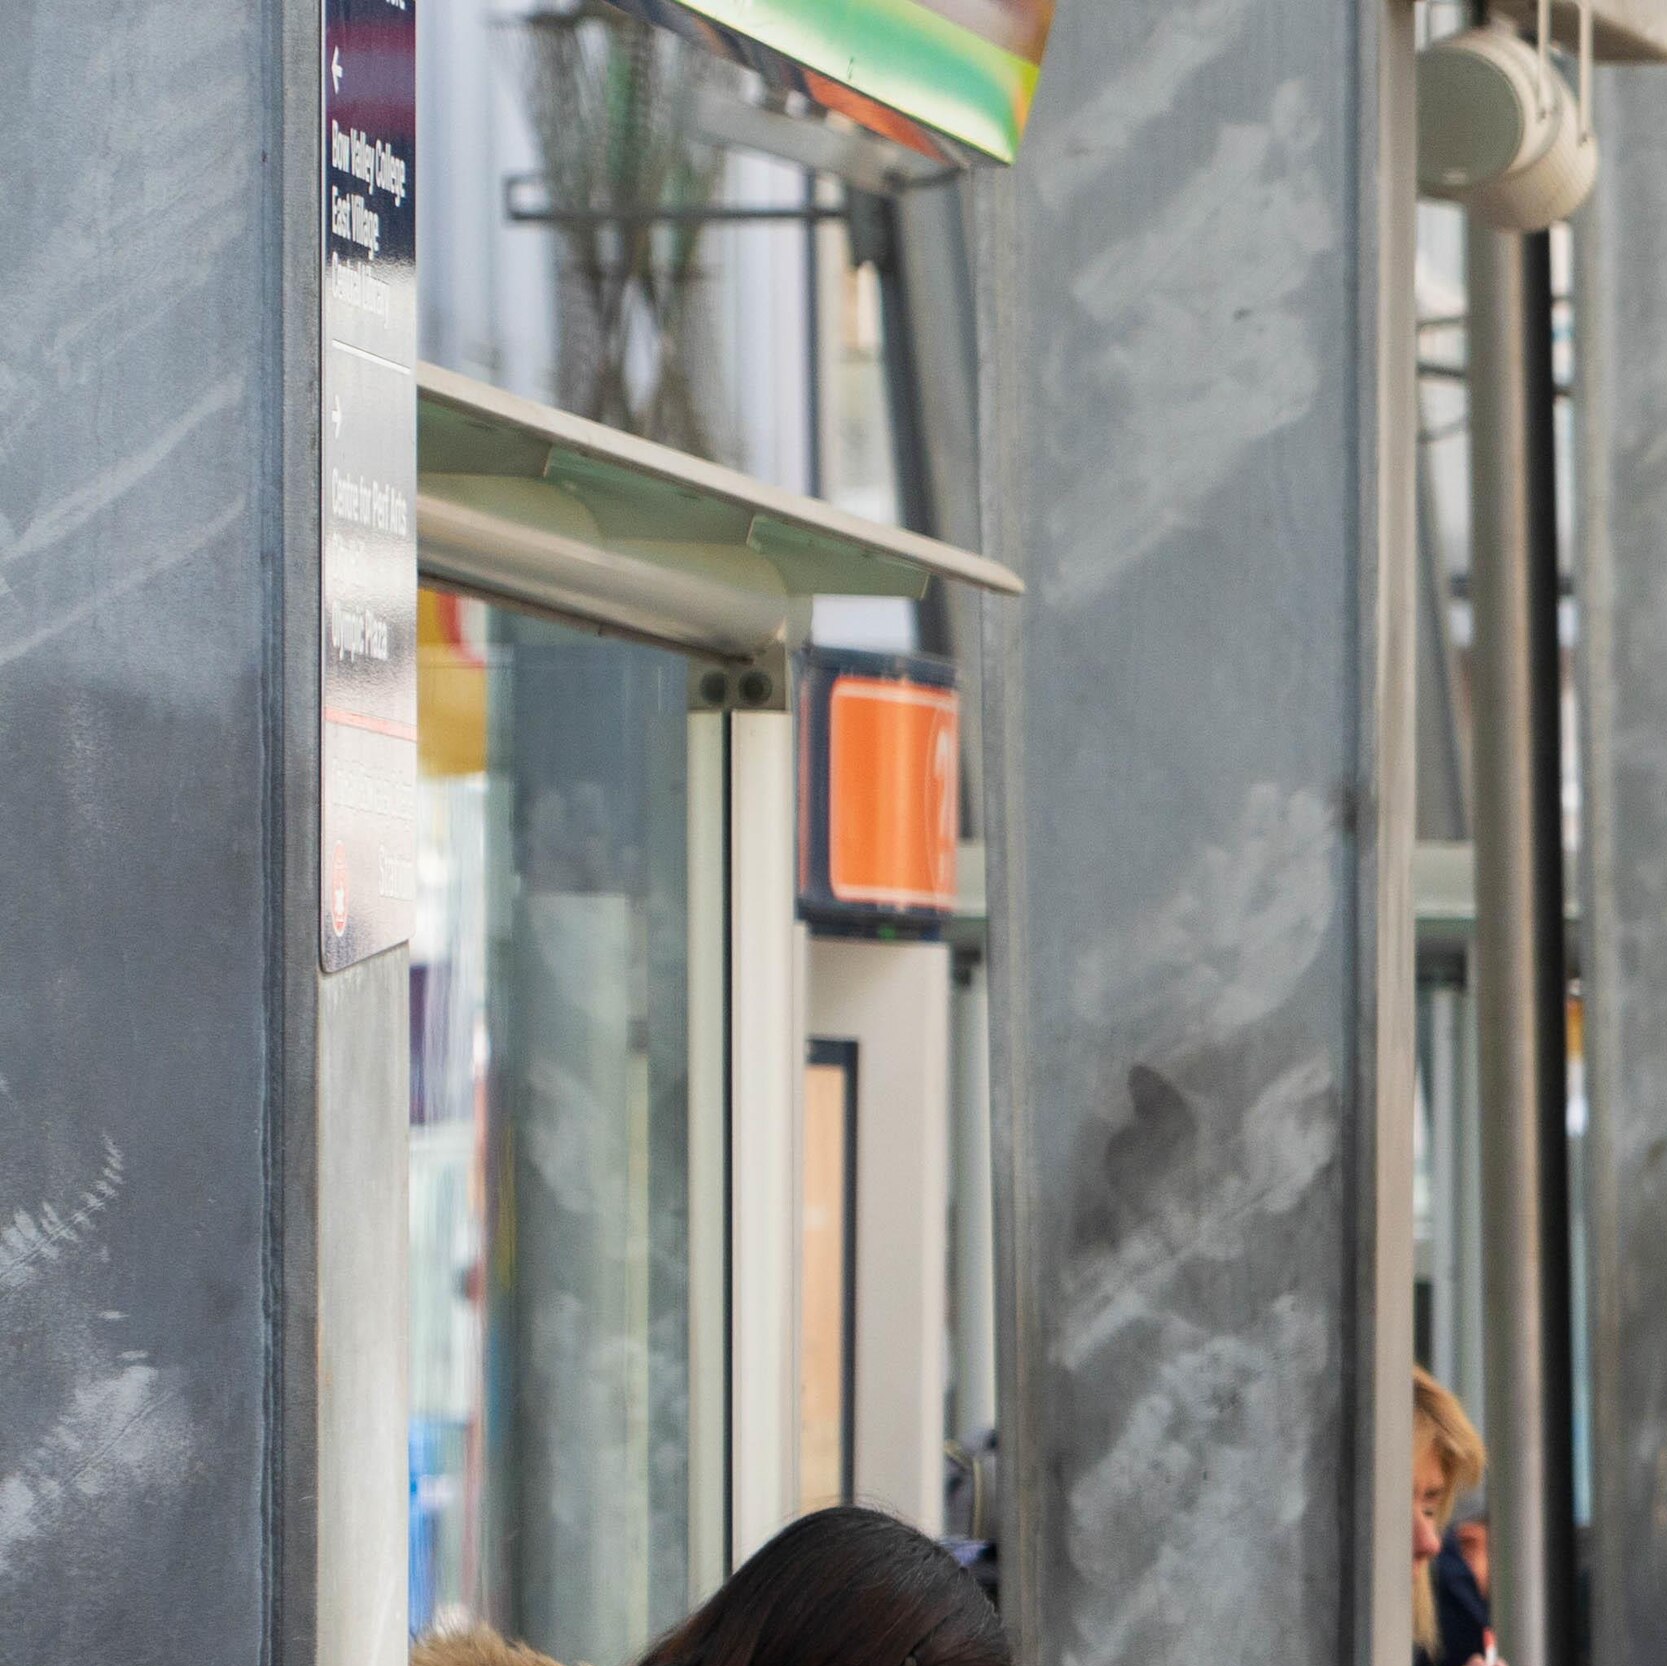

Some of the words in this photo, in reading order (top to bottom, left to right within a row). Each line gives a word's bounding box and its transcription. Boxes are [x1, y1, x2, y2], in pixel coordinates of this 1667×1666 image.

[332, 119, 350, 172] Bow
[350, 127, 375, 195] Valley
[375, 138, 406, 207] College
[332, 184, 350, 240] East
[351, 194, 379, 260] Village
